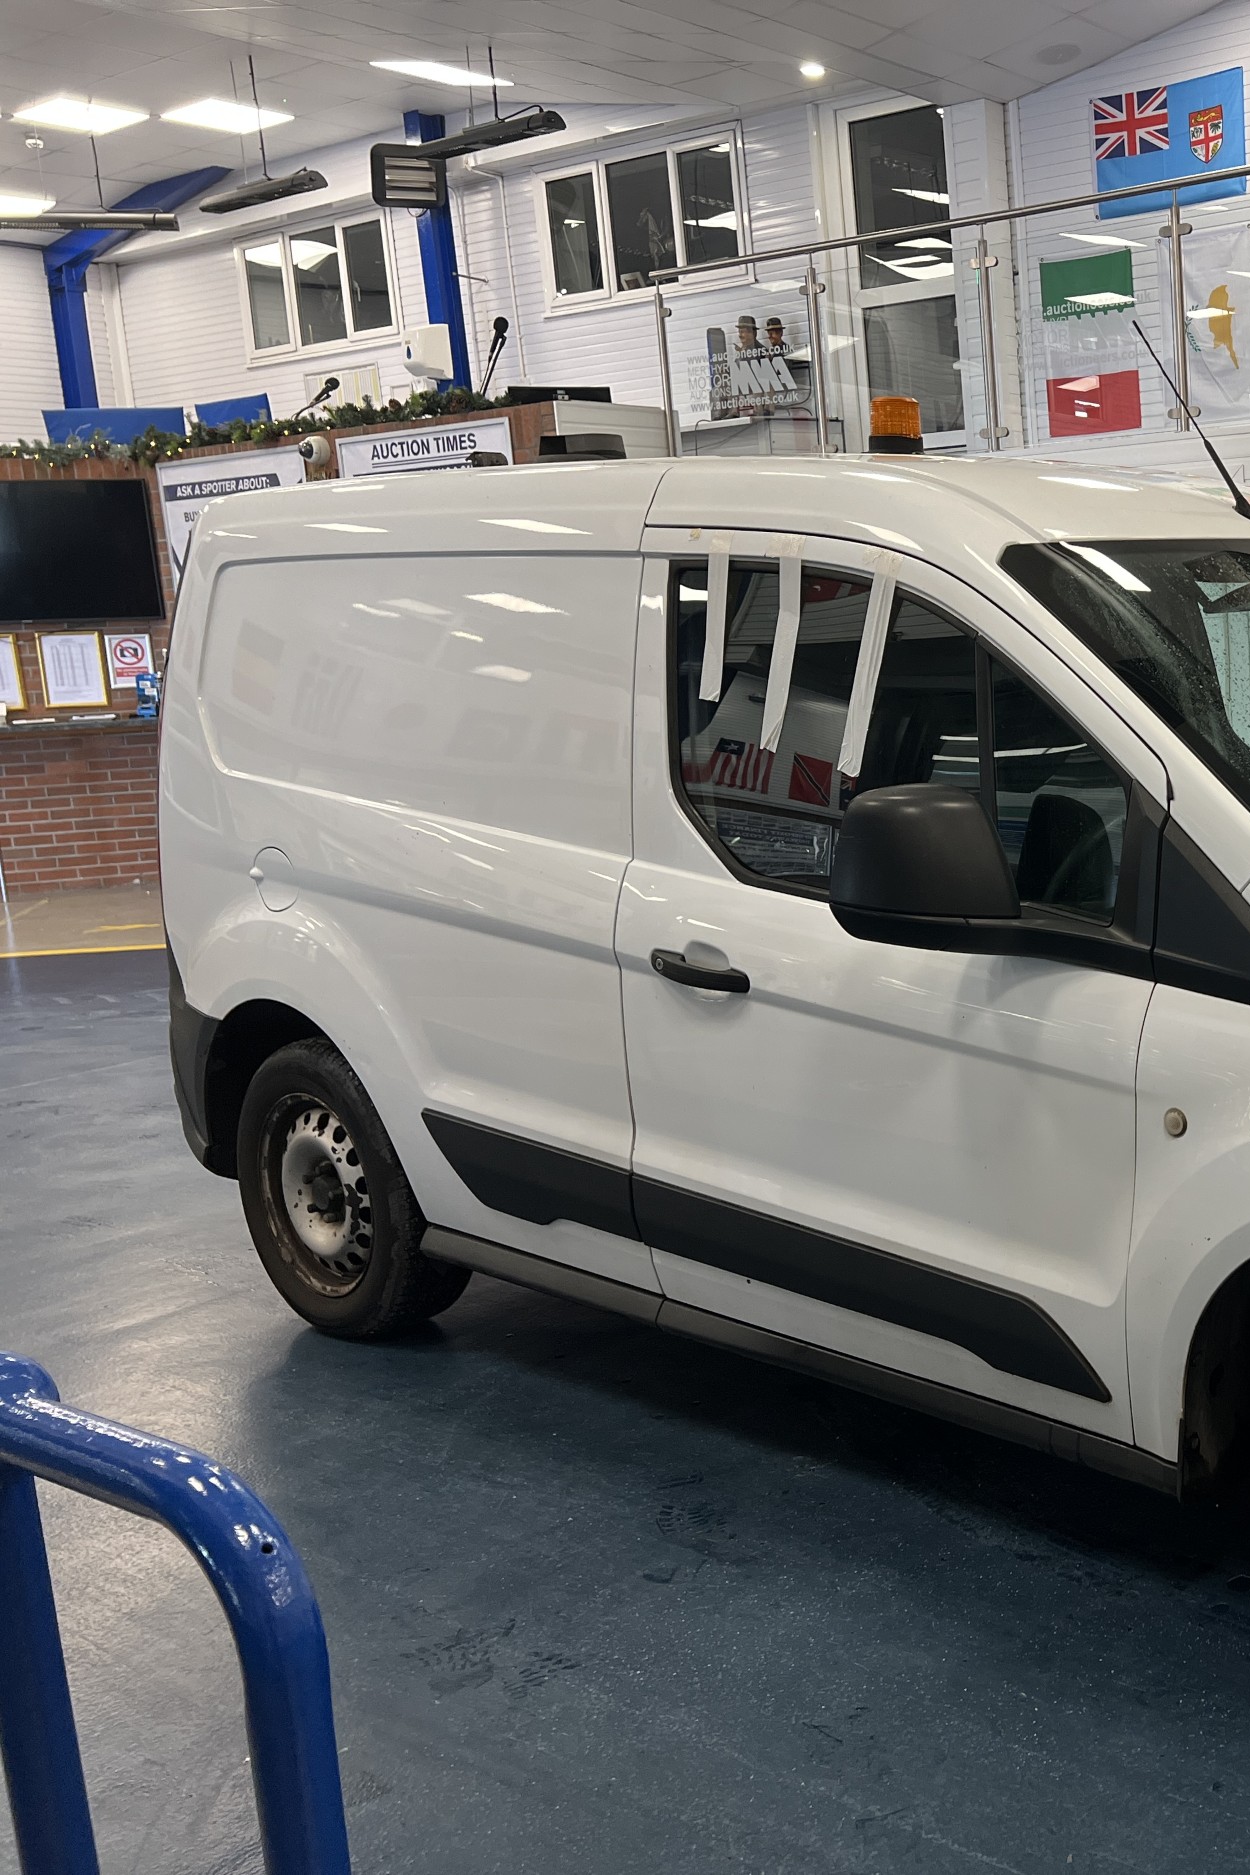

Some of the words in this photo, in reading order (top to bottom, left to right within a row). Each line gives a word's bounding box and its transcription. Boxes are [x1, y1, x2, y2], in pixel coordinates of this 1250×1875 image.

[688, 374, 731, 391] MOTOR
[691, 391, 799, 413] www.auctioneers.co.uk
[371, 438, 431, 461] AUCTION
[433, 433, 477, 453] TIMES
[176, 485, 193, 498] ASK
[194, 484, 201, 496] A
[201, 480, 236, 495] SPOTTER
[237, 477, 270, 491] ABOUT:
